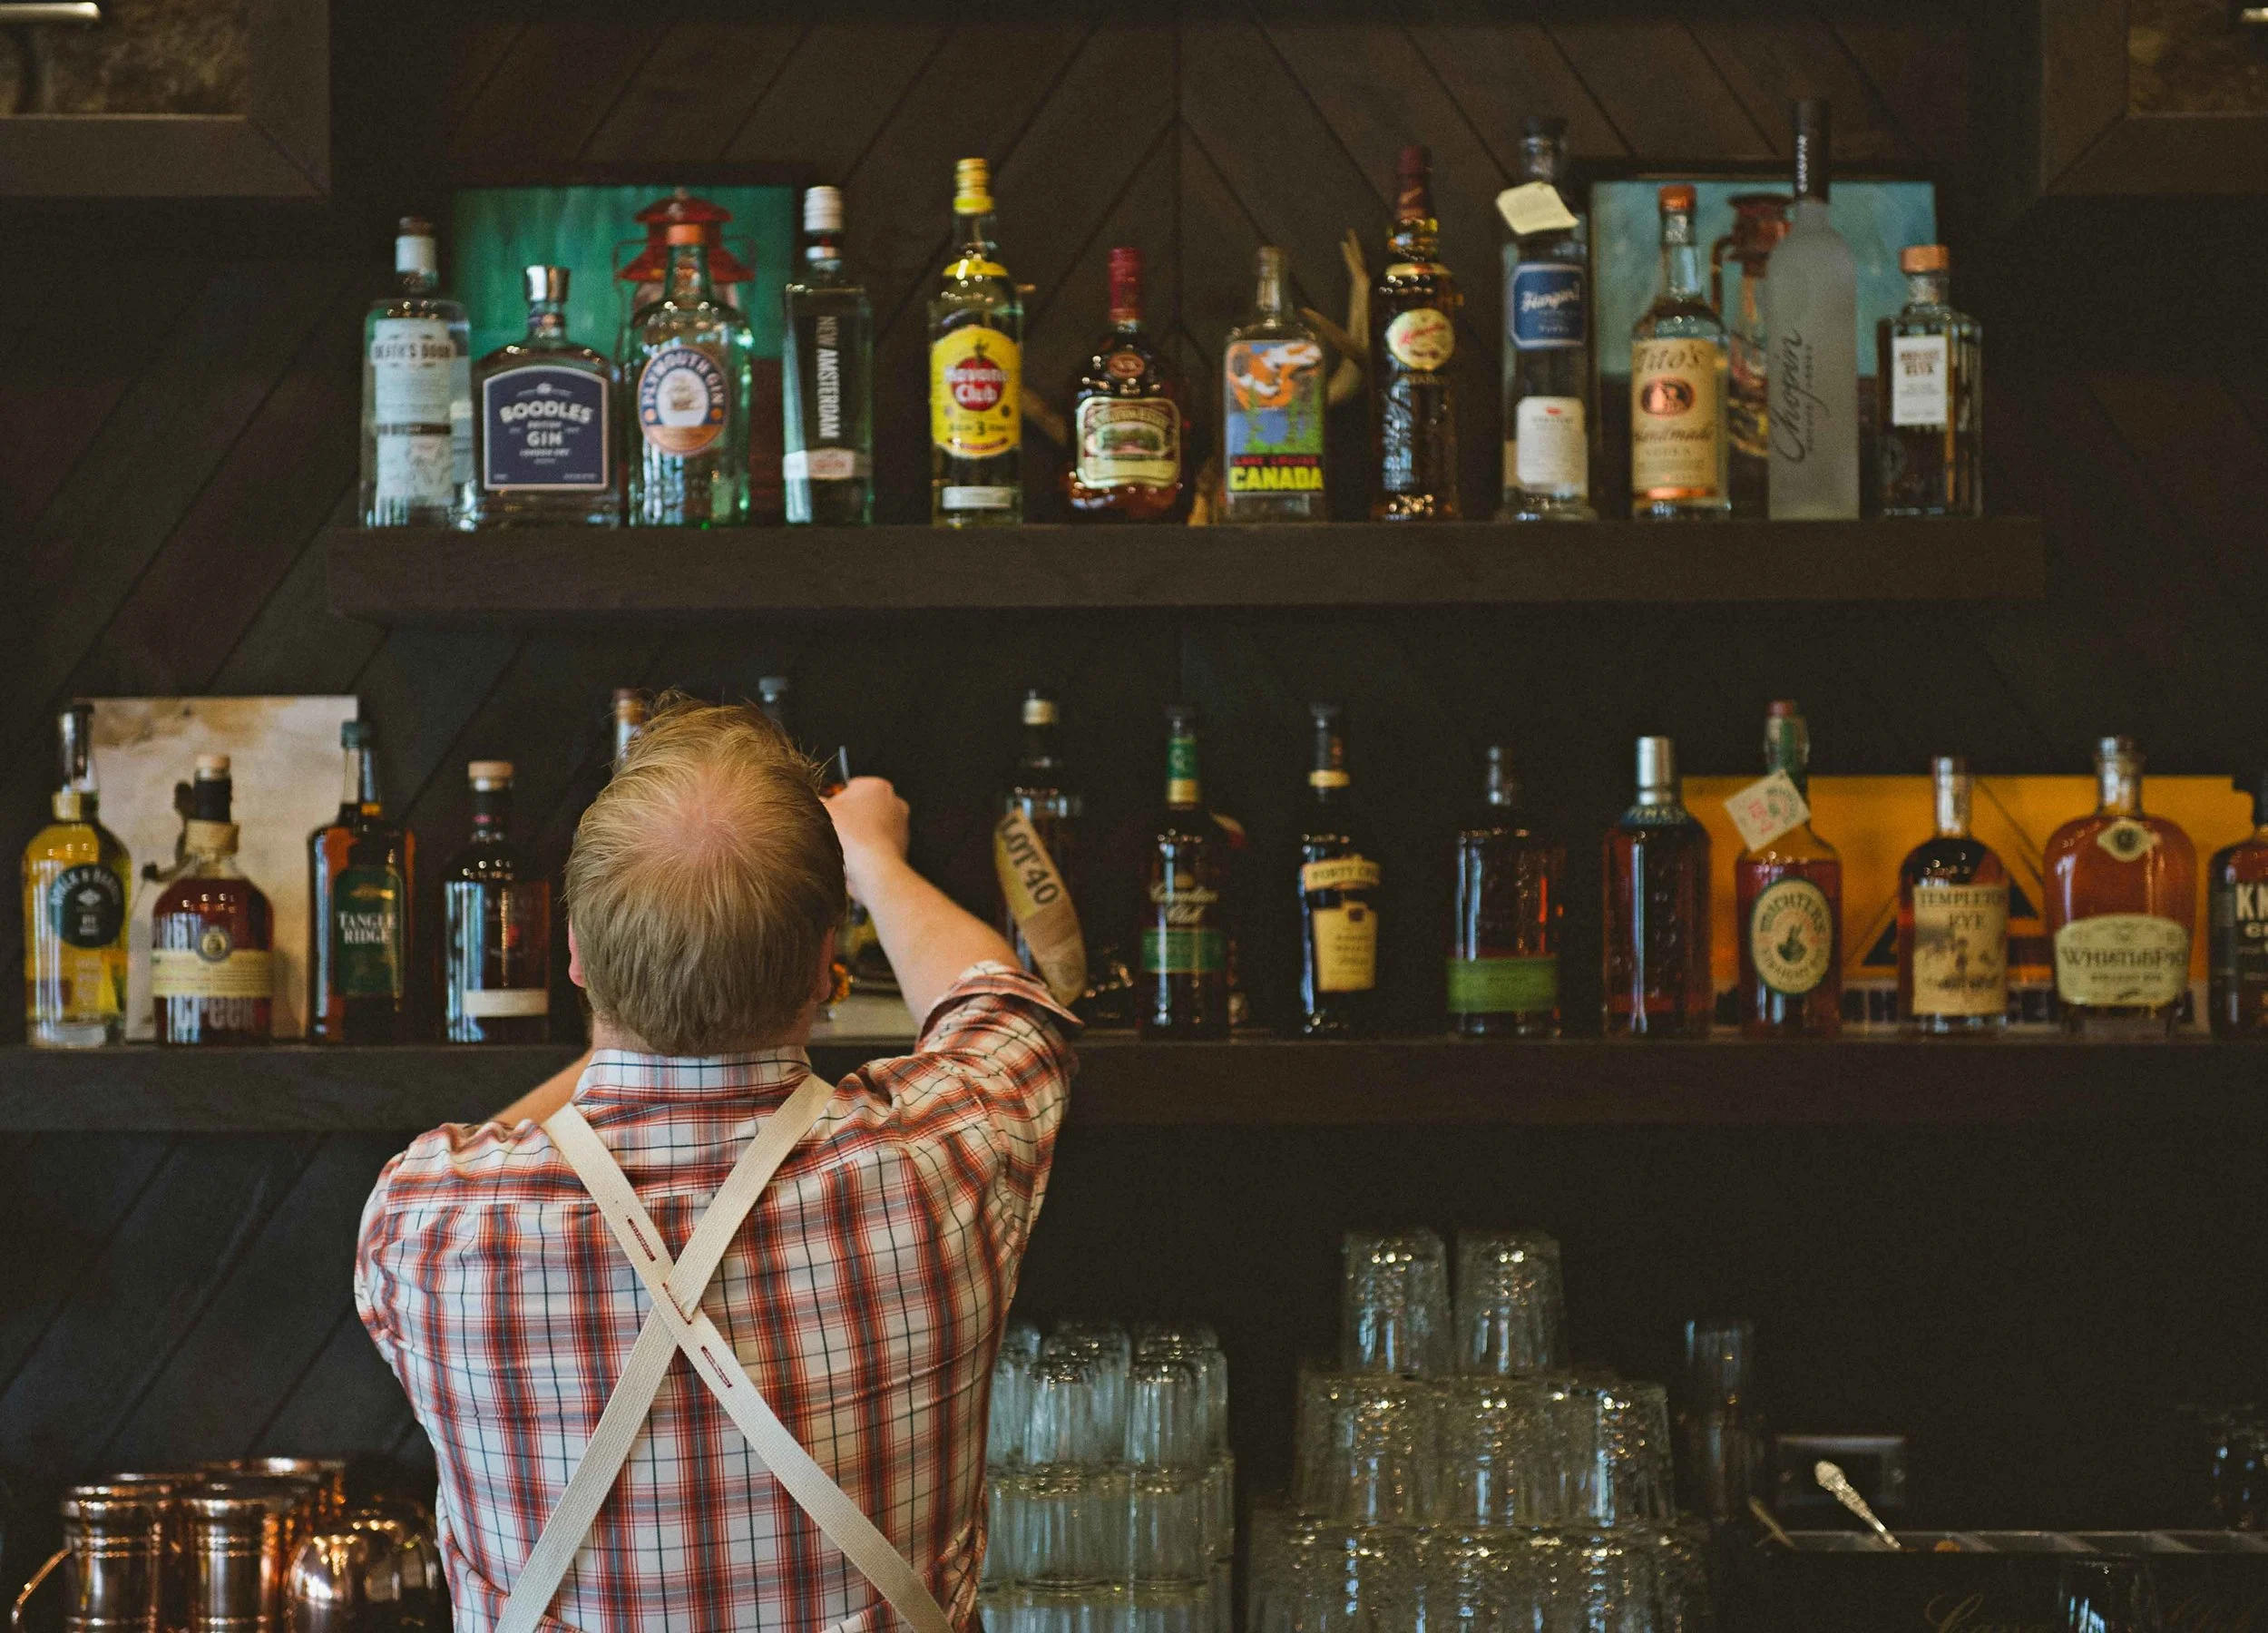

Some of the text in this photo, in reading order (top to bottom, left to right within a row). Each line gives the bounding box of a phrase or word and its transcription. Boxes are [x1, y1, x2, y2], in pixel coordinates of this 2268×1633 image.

[817, 317, 838, 347] NEW
[641, 351, 724, 406] PLYMOUTH GIN
[817, 348, 840, 437] AMSTERDAM
[955, 383, 998, 403] Club
[500, 400, 593, 425] BOODLES
[527, 431, 562, 447] GIN
[1230, 466, 1324, 490] CANADA
[1000, 816, 1060, 905] LOT 40
[337, 911, 396, 929] TANGLE
[1950, 914, 1984, 929] RYE
[344, 928, 392, 944] RIDGE
